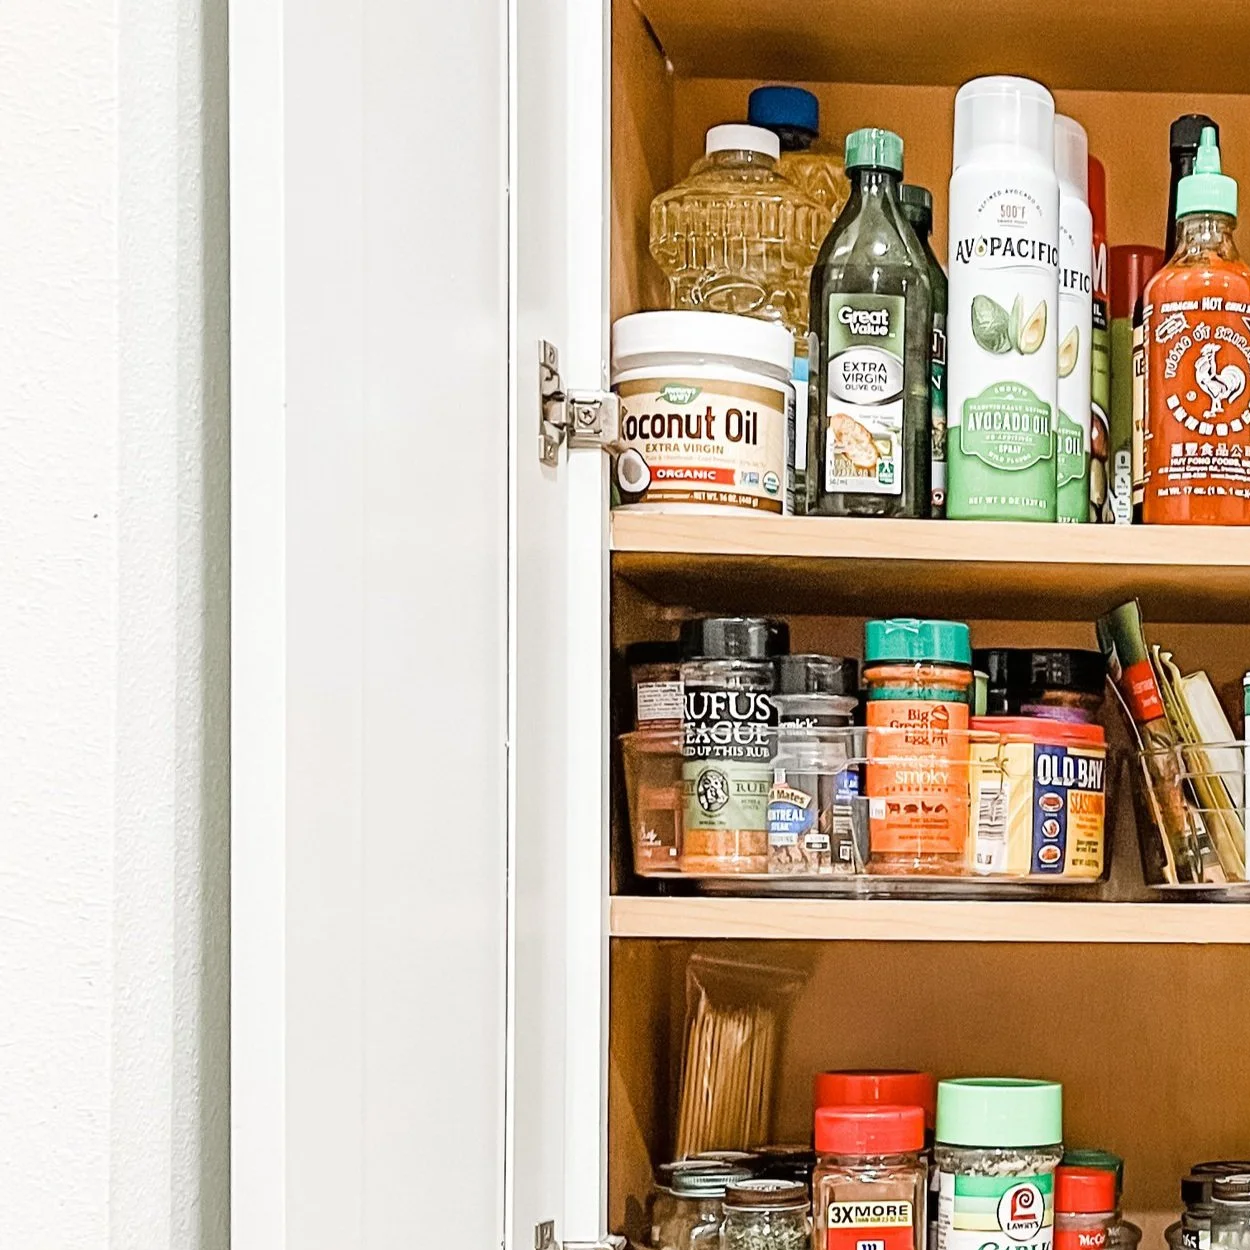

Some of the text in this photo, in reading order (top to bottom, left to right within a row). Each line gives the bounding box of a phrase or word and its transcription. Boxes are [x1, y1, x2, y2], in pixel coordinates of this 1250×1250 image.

[1202, 296, 1223, 311] HOT
[838, 306, 889, 326] Great
[849, 322, 889, 337] Value
[843, 361, 887, 374] EXTRA
[842, 373, 888, 385] VIRGIN
[845, 384, 885, 392] OLIVE OIL
[621, 406, 758, 446] oconut Oil
[967, 411, 1050, 437] AVOCADO OIL
[645, 443, 725, 455] EXTRA VIRGIN
[998, 444, 1023, 454] SPRAY
[1065, 436, 1082, 456] OIL
[1170, 457, 1187, 467] HUY
[656, 468, 717, 480] ORGANIC
[1183, 486, 1193, 496] 17
[908, 709, 930, 723] Big
[684, 721, 770, 745] EAGUE
[697, 746, 770, 758] UP THIS RUB
[895, 769, 950, 785] smoky
[1037, 754, 1103, 790] OLD BAY
[736, 782, 767, 793] RUB
[776, 789, 805, 805] Mates
[831, 1205, 909, 1224] 3X MORE
[1006, 1221, 1039, 1231] LAWRY'S
